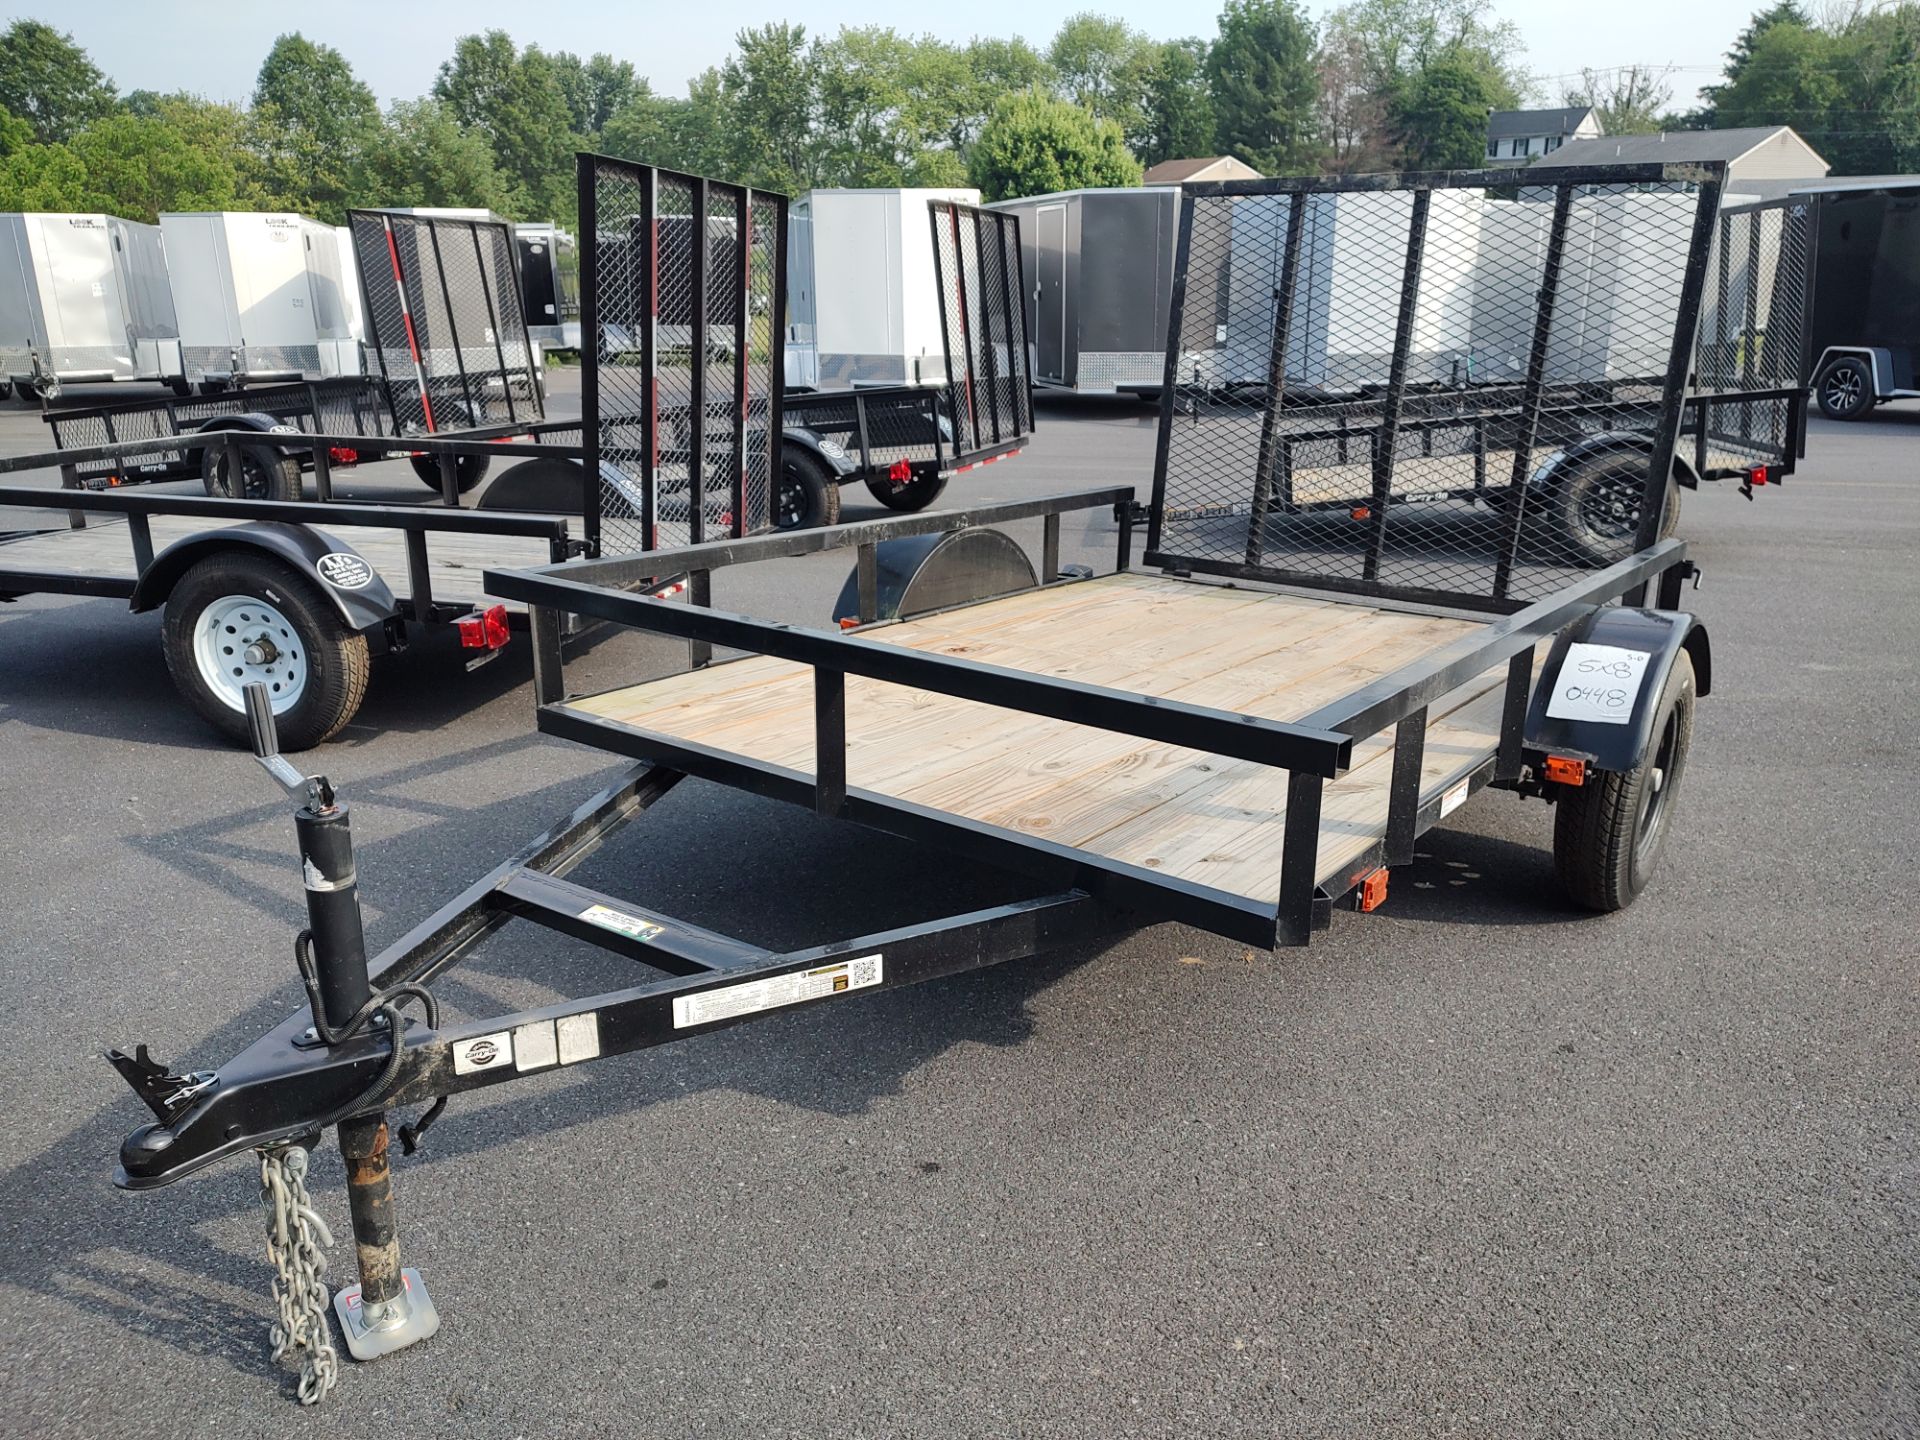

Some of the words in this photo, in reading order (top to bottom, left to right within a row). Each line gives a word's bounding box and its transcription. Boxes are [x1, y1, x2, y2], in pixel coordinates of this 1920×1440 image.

[140, 463, 167, 473] Carry-On
[1566, 686, 1627, 707] 0448
[465, 1047, 499, 1059] Carry-On
